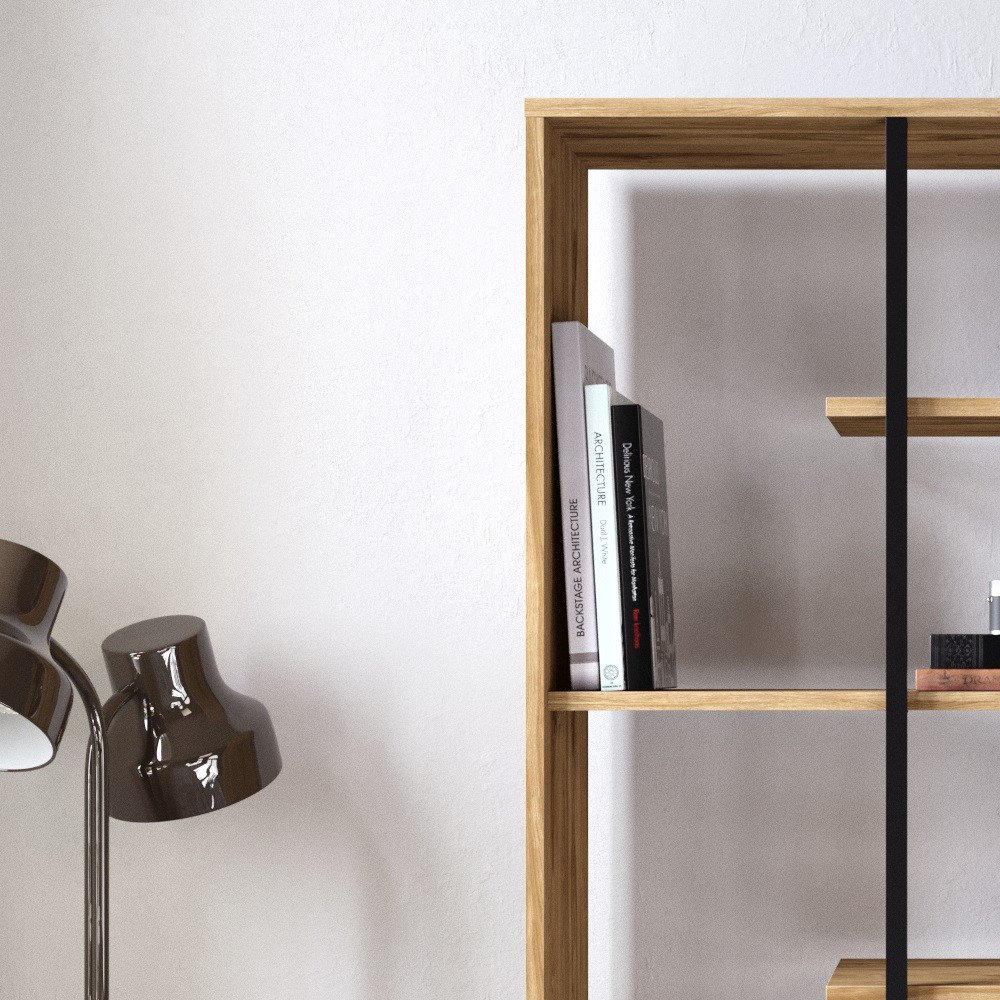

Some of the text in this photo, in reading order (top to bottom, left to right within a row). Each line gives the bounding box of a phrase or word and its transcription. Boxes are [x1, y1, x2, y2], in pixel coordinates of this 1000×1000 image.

[594, 431, 606, 506] ARCHITECTURE
[622, 442, 633, 474] Delirious
[624, 475, 633, 494] New
[625, 495, 635, 512] York
[569, 498, 585, 637] BACKSTAGE ARCHITECTURE
